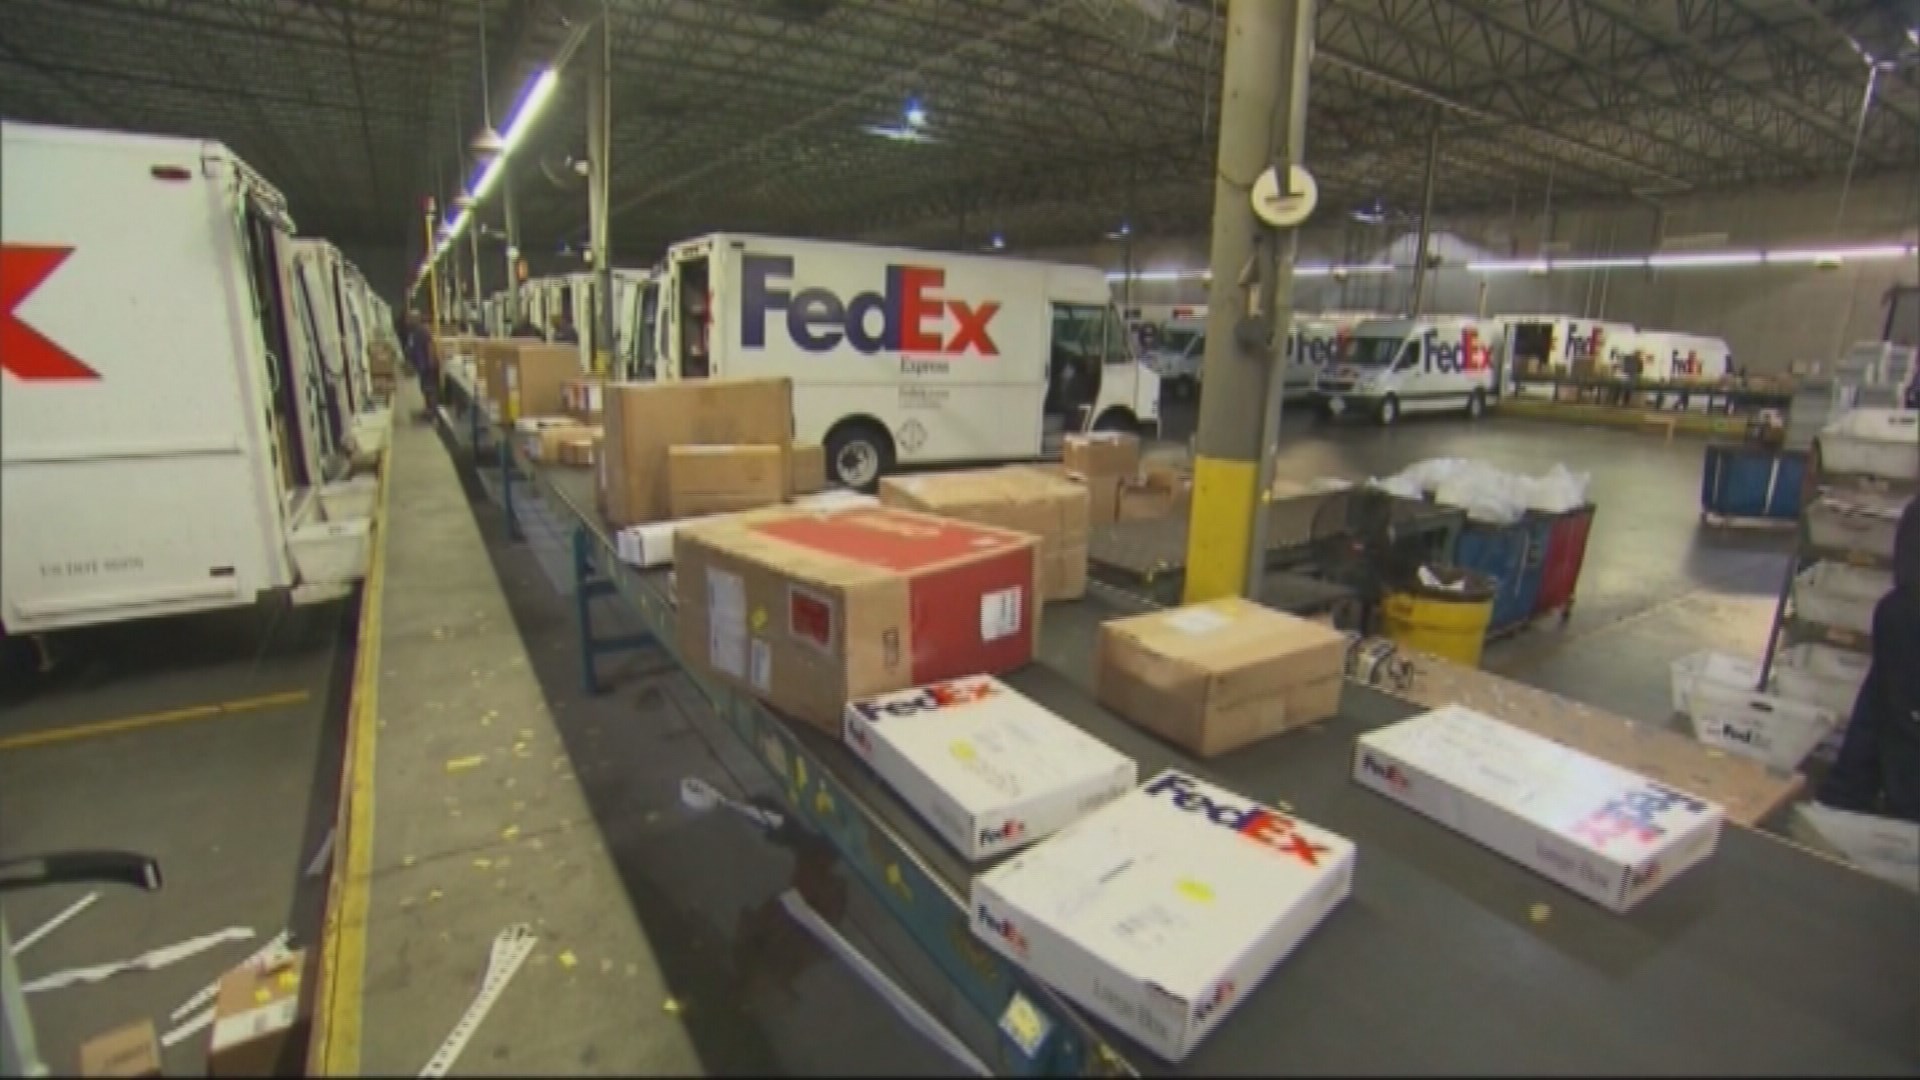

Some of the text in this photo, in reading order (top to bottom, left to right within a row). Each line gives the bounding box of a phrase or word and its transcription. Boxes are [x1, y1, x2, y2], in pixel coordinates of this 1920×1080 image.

[741, 254, 1001, 356] FedEx
[1423, 327, 1494, 376] FedEx
[855, 674, 1003, 721] FedEx
[978, 817, 1025, 849] FedEx
[1145, 772, 1334, 867] FedEx
[978, 902, 1030, 959] FedEx
